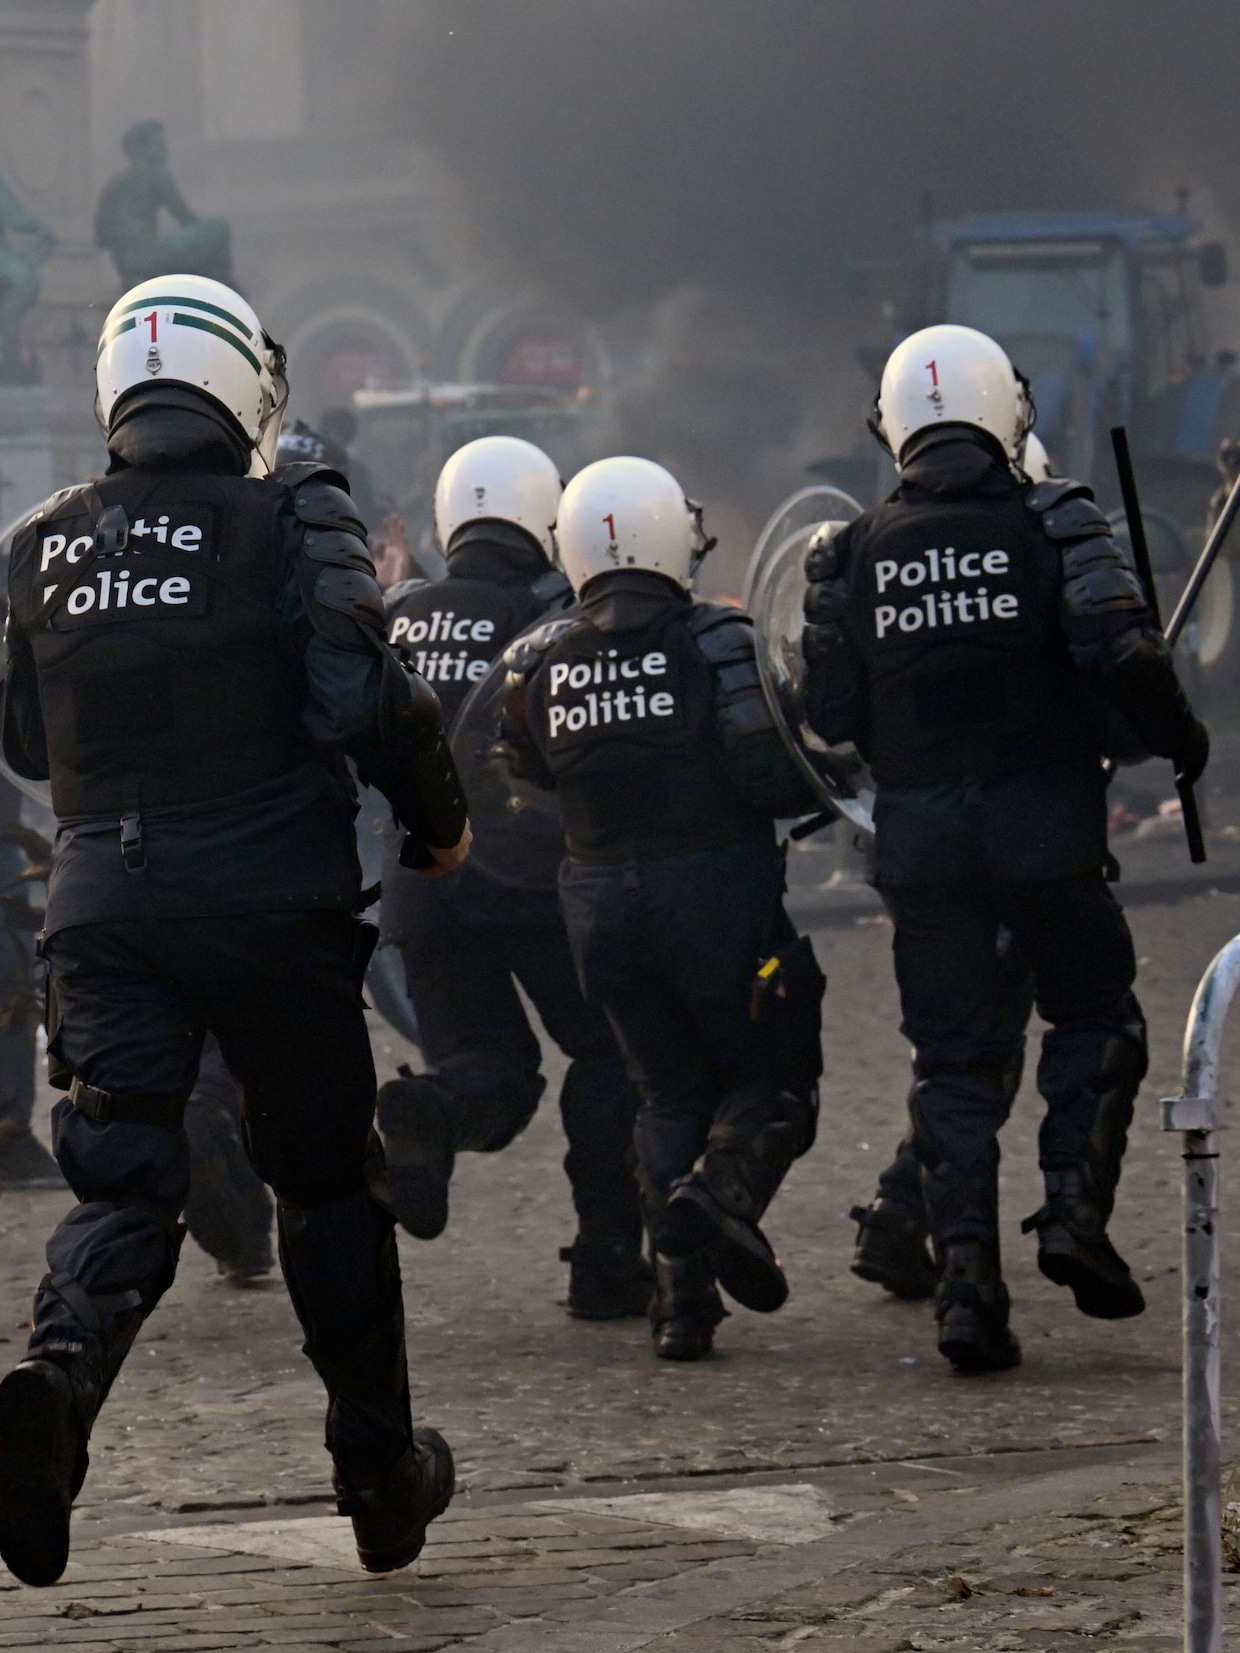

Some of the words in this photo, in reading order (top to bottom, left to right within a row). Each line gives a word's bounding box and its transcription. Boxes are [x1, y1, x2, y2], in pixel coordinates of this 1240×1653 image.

[144, 311, 158, 343] 1
[925, 360, 939, 386] 1
[40, 515, 203, 573] Potie
[603, 513, 616, 540] 1
[875, 547, 1009, 593] Police
[388, 610, 495, 644] Police
[875, 587, 1019, 639] Politie
[410, 650, 491, 682] litie
[549, 649, 667, 696] Police
[548, 685, 674, 738] Politie
